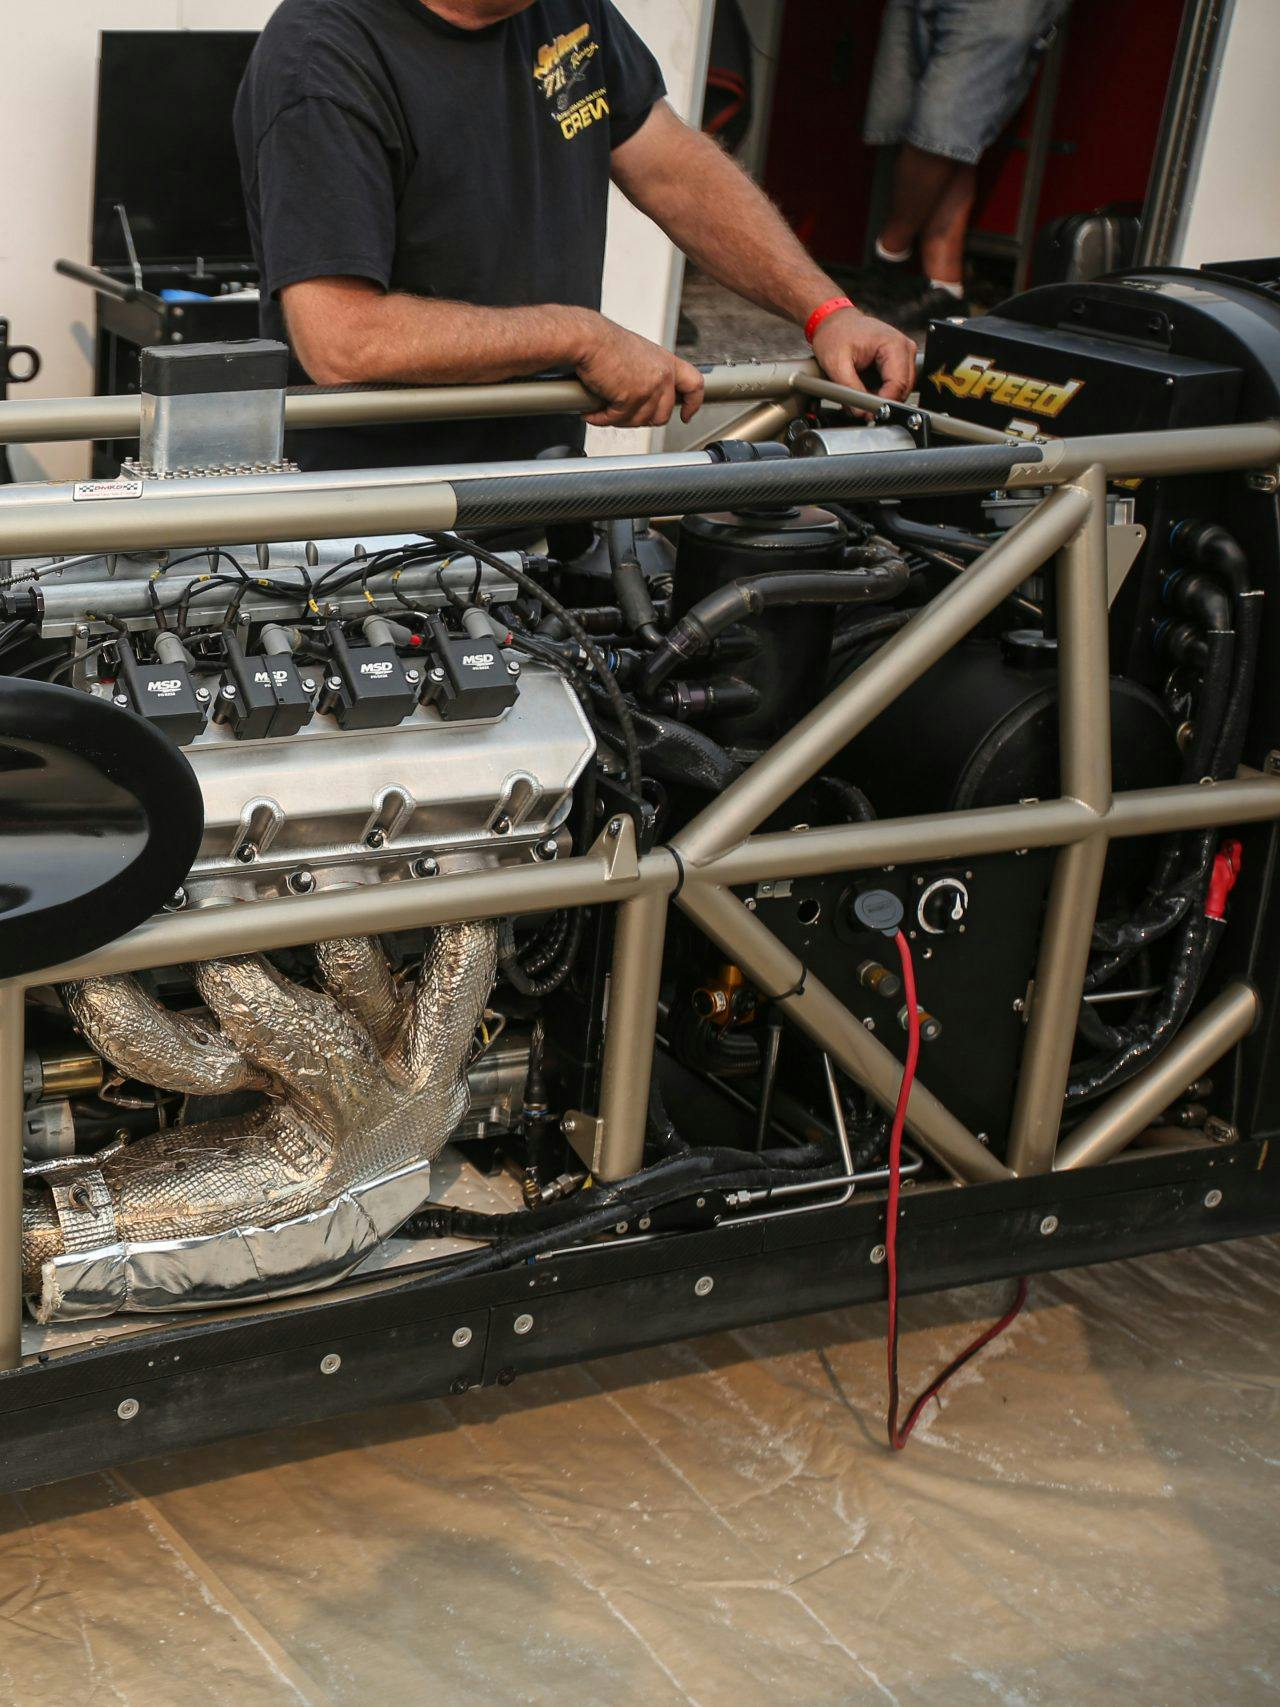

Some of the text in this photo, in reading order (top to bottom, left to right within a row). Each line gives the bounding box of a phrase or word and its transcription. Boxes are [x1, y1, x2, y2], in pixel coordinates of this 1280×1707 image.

[463, 654, 494, 664] MSD
[360, 662, 393, 673] MSD
[147, 680, 181, 691] MSD
